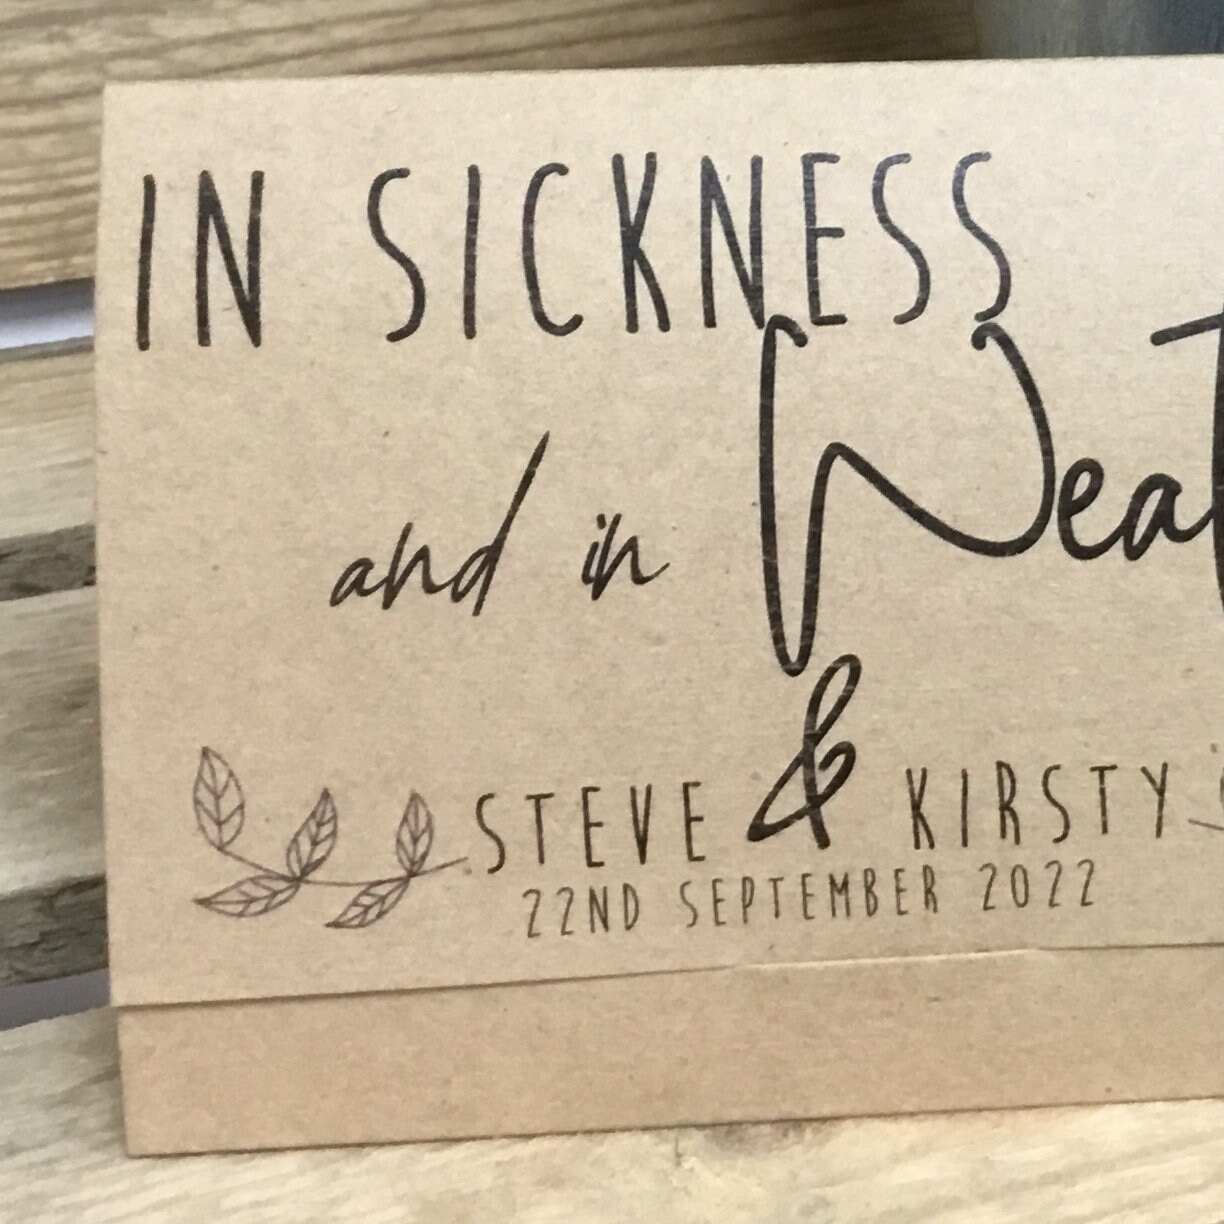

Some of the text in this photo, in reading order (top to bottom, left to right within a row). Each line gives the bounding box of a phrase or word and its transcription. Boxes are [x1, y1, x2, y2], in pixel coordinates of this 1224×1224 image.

[135, 150, 1013, 350] IN SICKNESS
[328, 431, 551, 618] and
[580, 511, 671, 602] in
[475, 653, 1169, 875] STEVE & KIRSTY
[522, 858, 1095, 939] 22ND SEPTEMBER 2022
